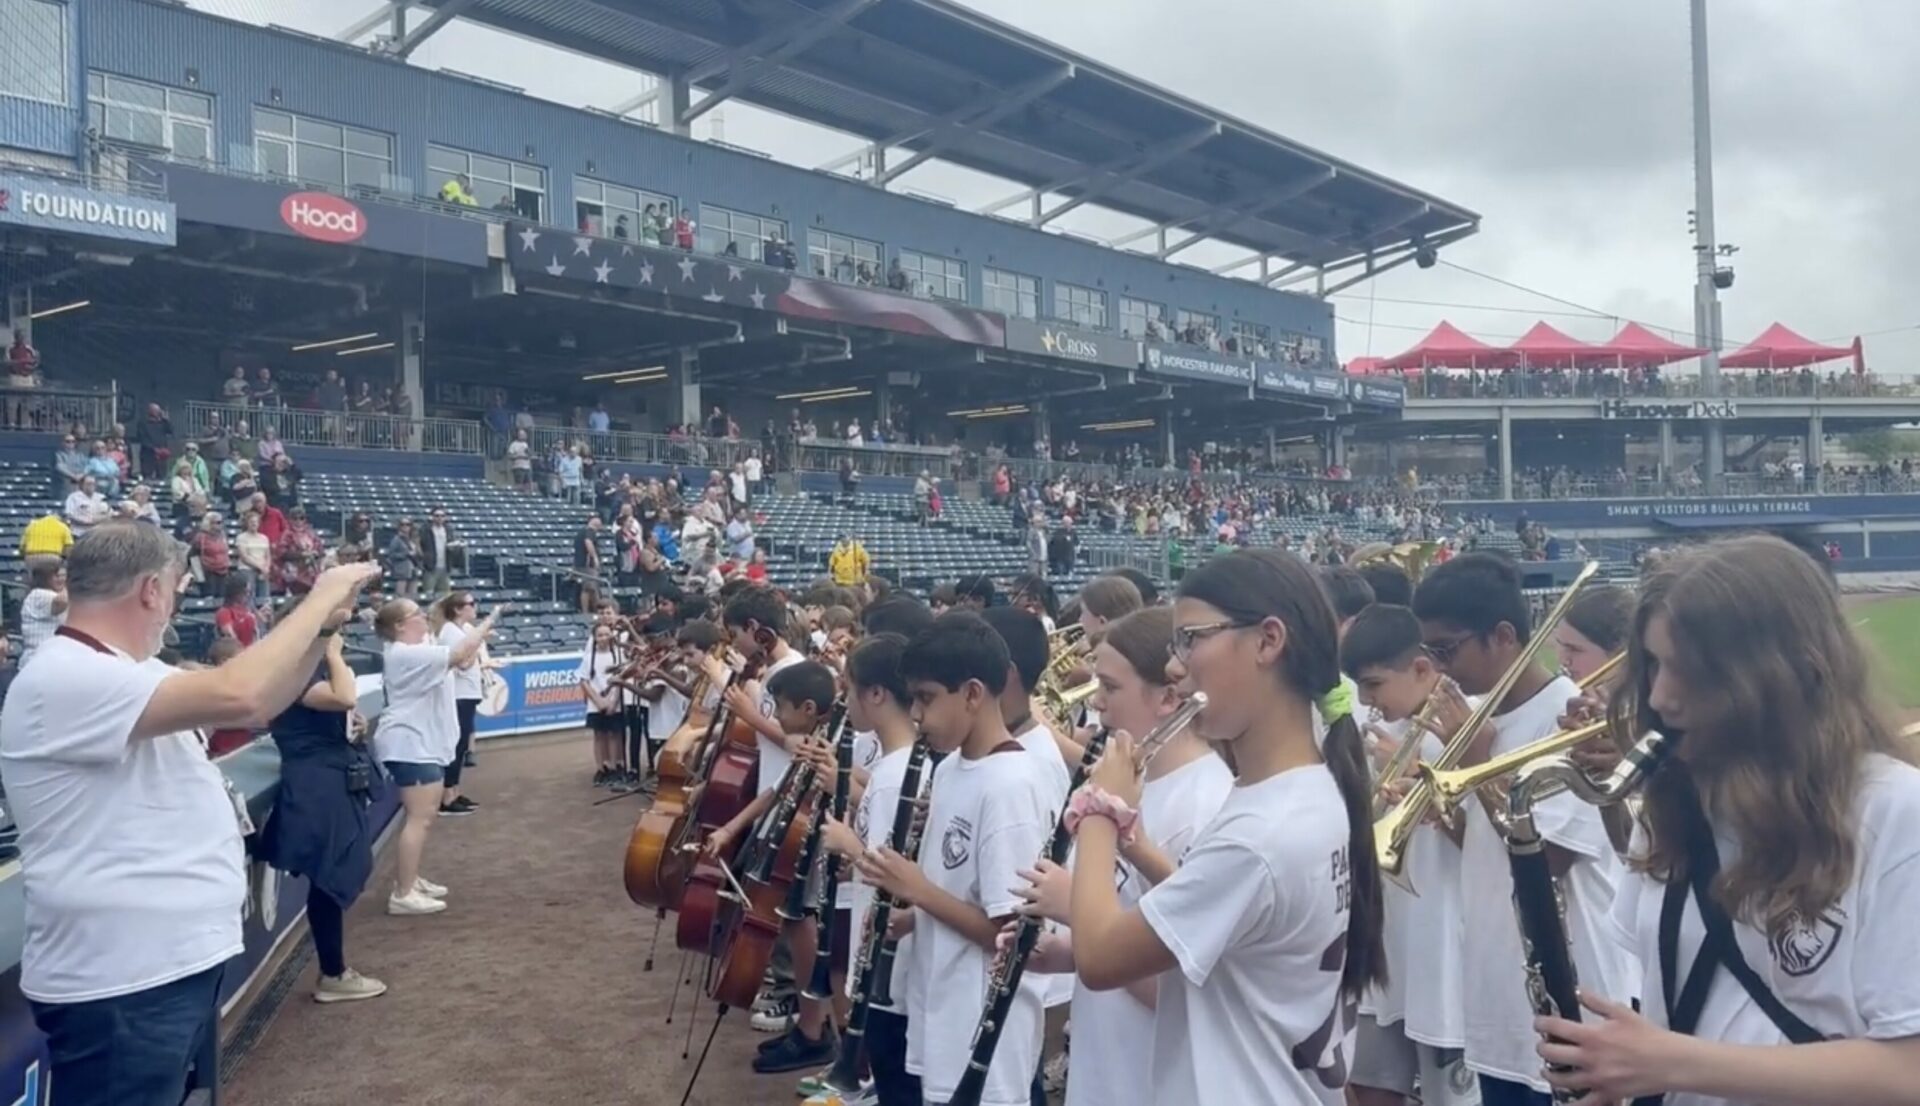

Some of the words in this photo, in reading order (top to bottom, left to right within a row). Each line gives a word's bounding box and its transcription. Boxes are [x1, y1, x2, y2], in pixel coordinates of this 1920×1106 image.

[21, 190, 167, 233] FOUNDATION
[291, 199, 358, 233] Hood
[1161, 354, 1208, 372] WORCESTER
[1602, 400, 1692, 418] Hanover
[1693, 400, 1736, 418] Deck
[1606, 505, 1650, 516] SHAW'S
[1653, 503, 1706, 515] VISITORS
[1710, 502, 1760, 514] BULLPEN
[1762, 501, 1811, 513] TERRACE
[524, 669, 581, 689] WORCES
[526, 684, 586, 706] REGIONA
[1331, 846, 1350, 881] PA
